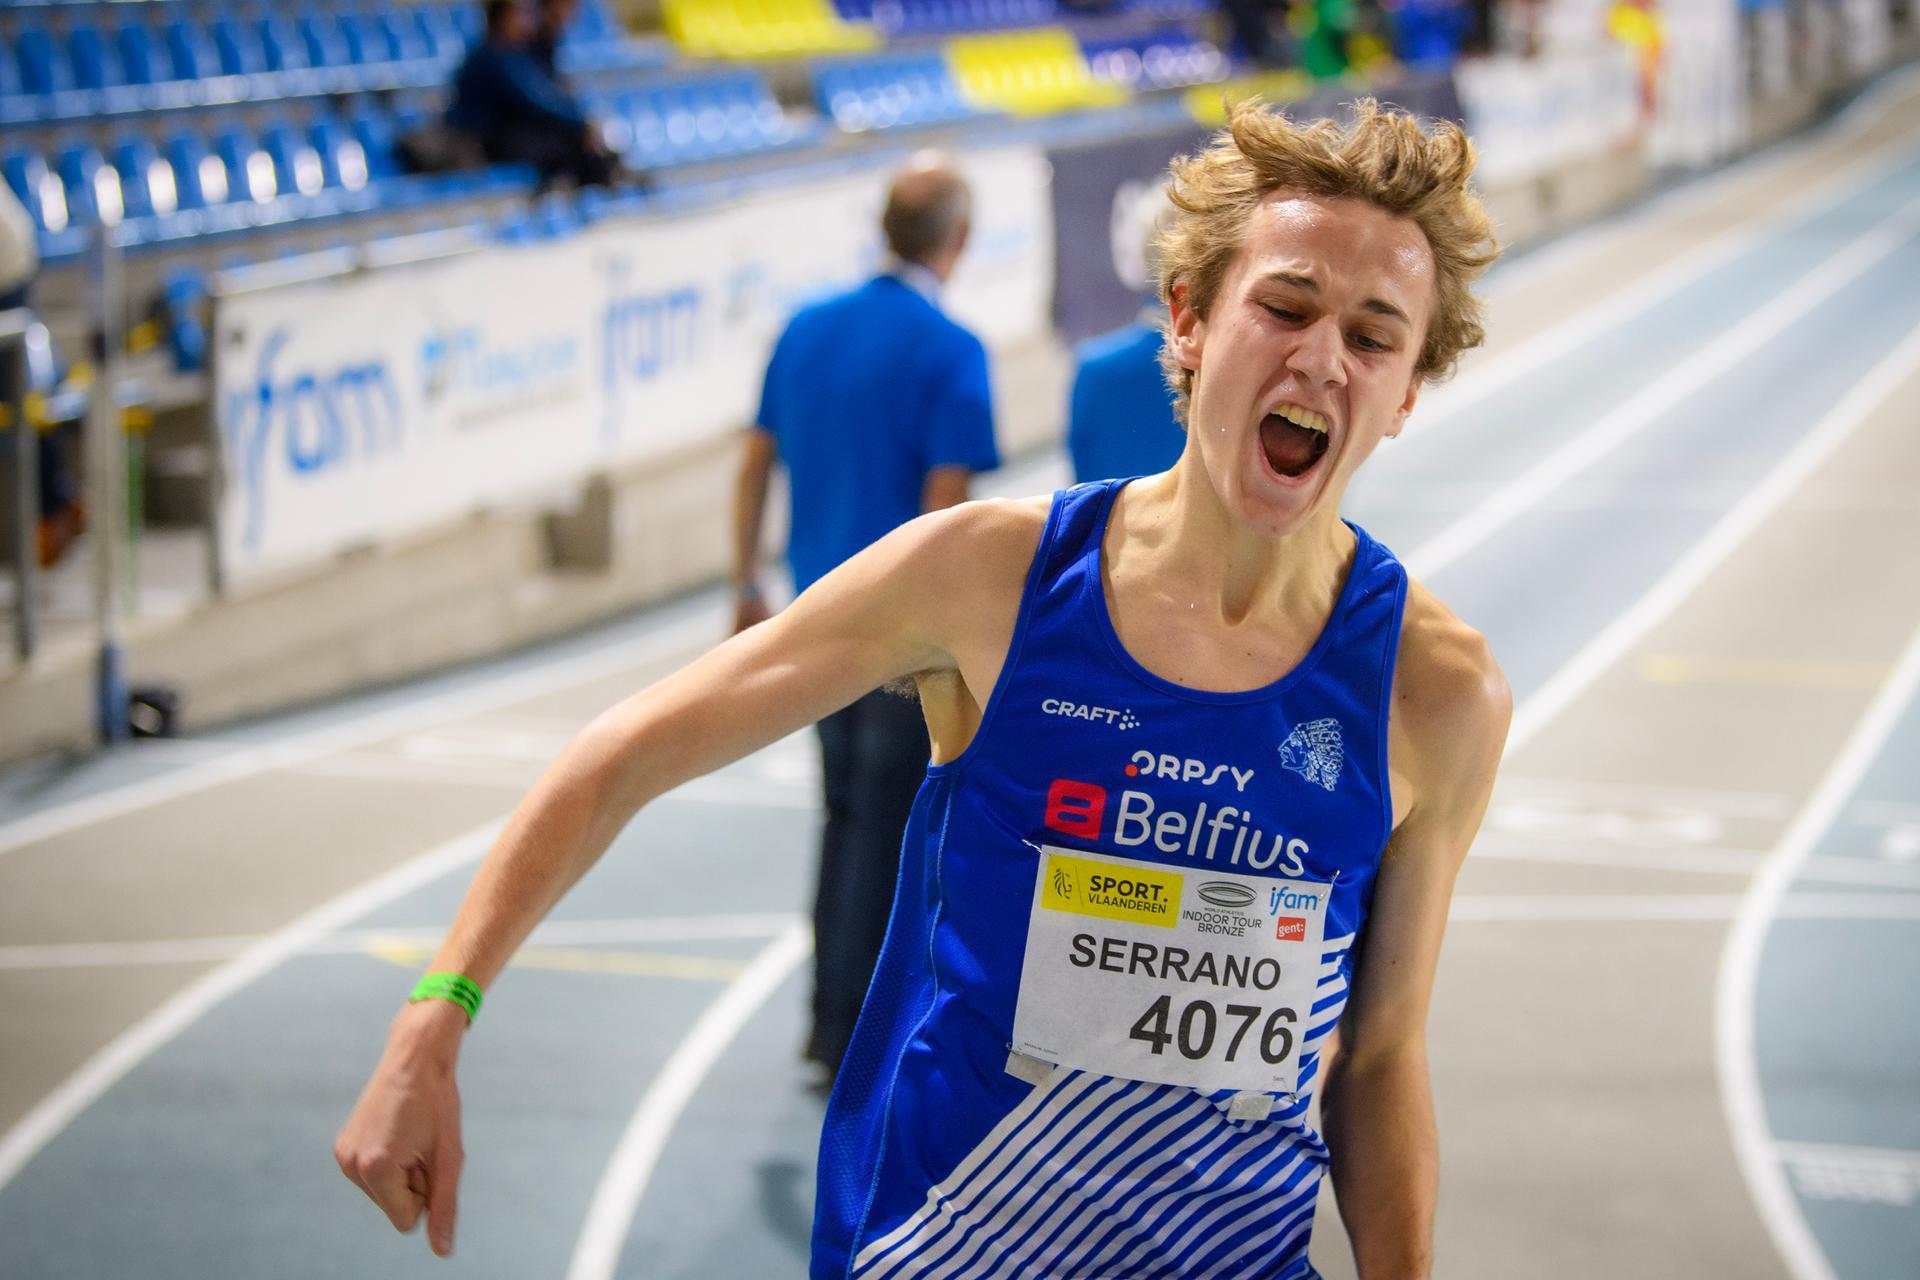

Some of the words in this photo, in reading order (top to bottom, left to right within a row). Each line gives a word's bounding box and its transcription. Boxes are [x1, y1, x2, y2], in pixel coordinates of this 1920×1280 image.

[1041, 698, 1121, 725] CRAFT
[1125, 749, 1255, 793] ORPSY
[1113, 789, 1310, 878] Belfius
[1088, 892, 1167, 914] VLAANDEREN
[1269, 885, 1319, 916] ifam
[1182, 909, 1229, 926] INDOOR
[1231, 915, 1263, 929] TOUR
[1197, 922, 1245, 938] BRONZE
[1068, 933, 1281, 992] SERRANO
[1129, 994, 1298, 1066] 4076
